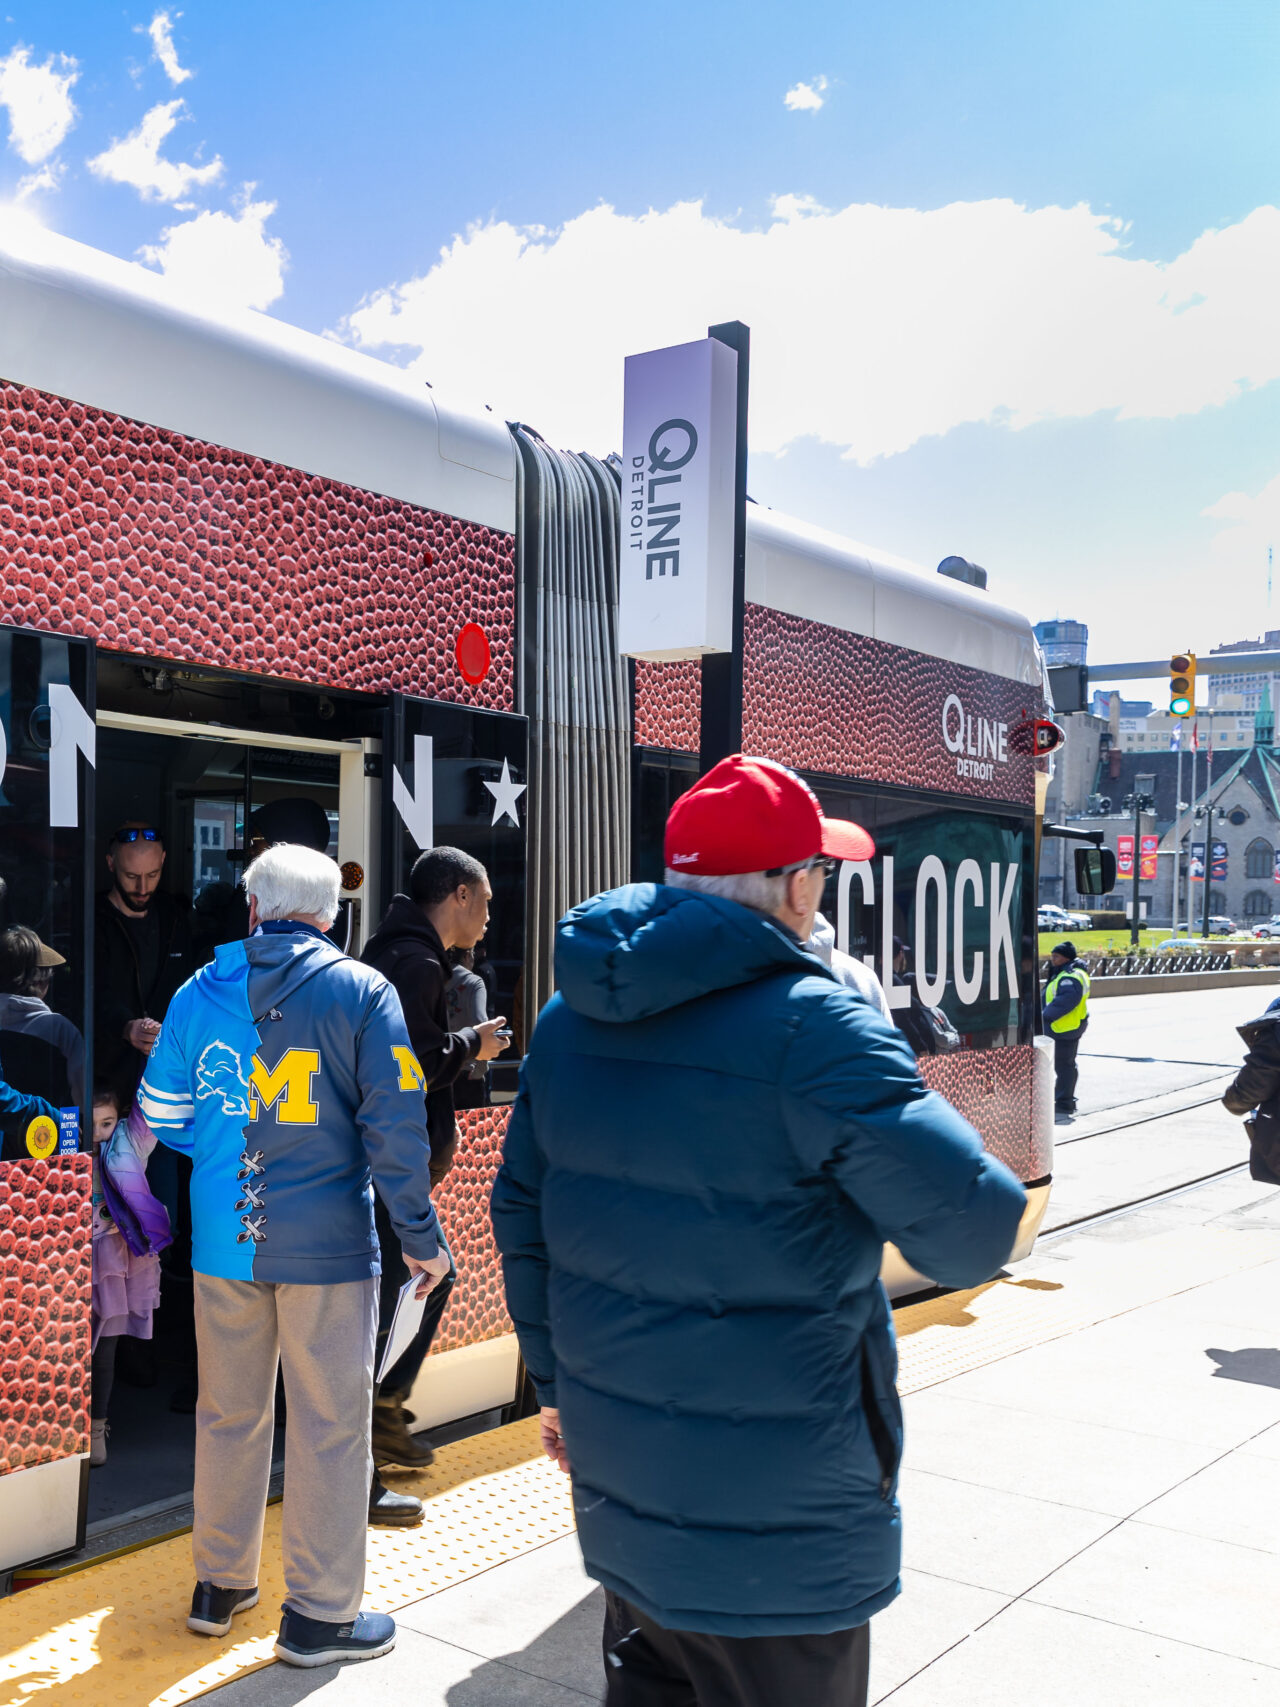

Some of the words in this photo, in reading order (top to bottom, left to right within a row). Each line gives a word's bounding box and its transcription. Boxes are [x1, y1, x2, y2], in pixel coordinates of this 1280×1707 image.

[630, 455, 645, 551] DETROIT
[645, 418, 699, 580] QLINE
[942, 693, 1008, 763] QLINE
[956, 756, 994, 781] DETROIT
[837, 854, 1020, 1010] CLOCK
[248, 1046, 321, 1126] M
